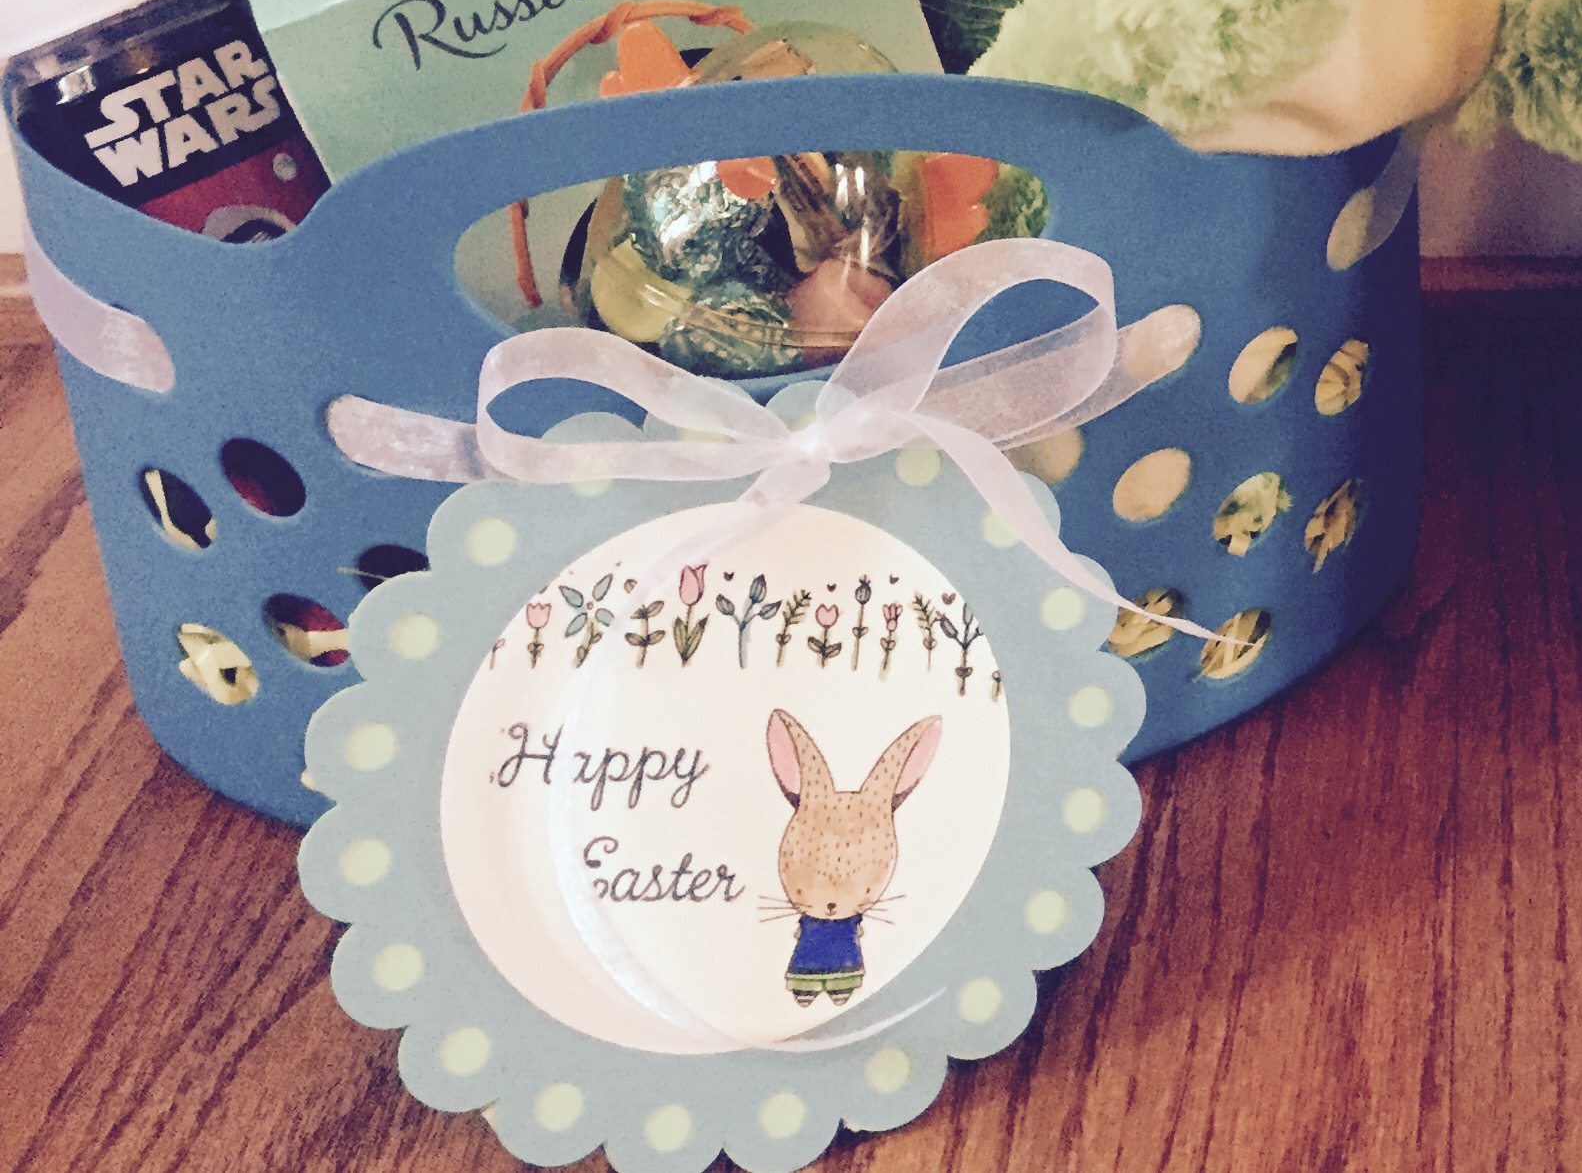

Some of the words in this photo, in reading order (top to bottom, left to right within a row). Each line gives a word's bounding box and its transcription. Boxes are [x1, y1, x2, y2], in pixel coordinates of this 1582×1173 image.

[84, 40, 269, 149] STAR
[93, 74, 281, 187] WARS
[583, 836, 746, 903] Easter
